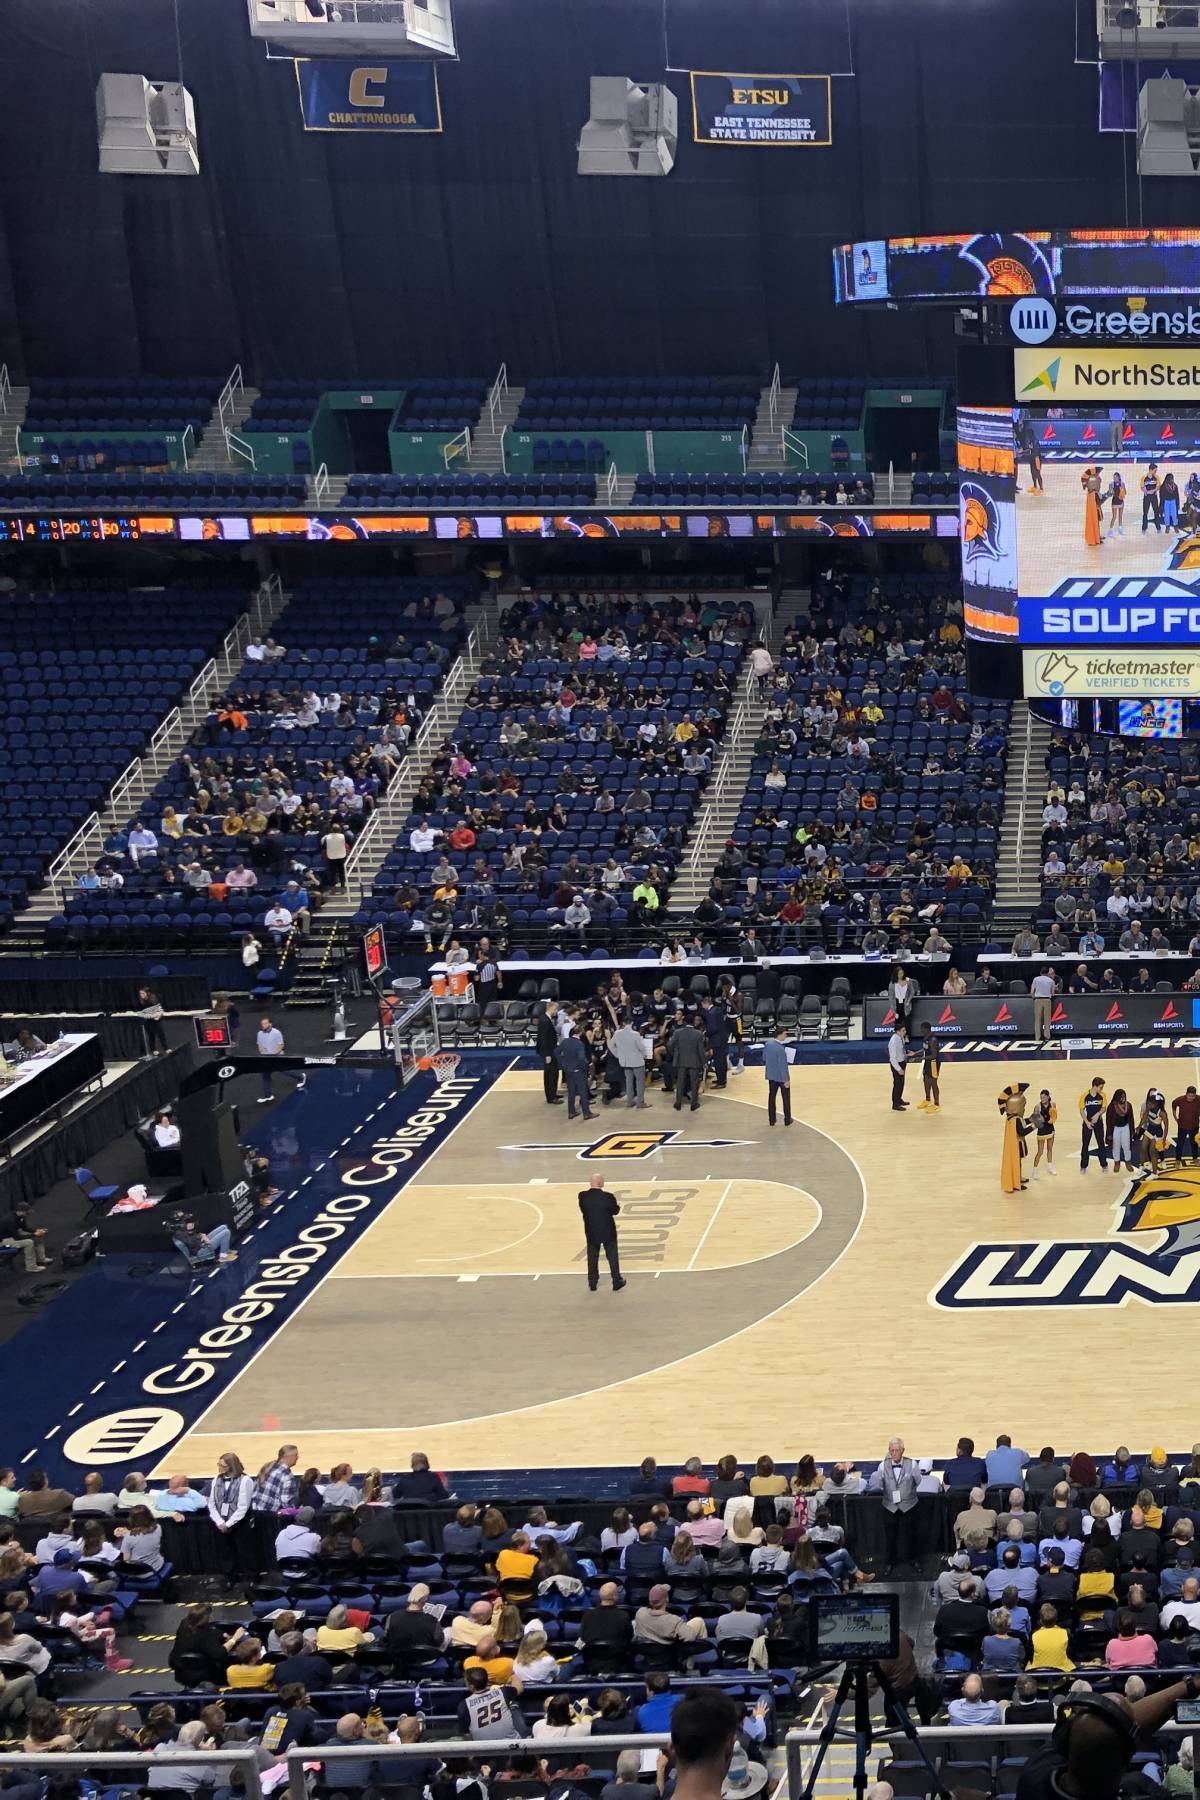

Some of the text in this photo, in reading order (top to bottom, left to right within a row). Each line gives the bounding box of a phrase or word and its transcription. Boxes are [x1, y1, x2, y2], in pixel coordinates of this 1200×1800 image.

[349, 67, 388, 107] C
[732, 89, 789, 105] ETSU
[328, 112, 417, 124] CHATTANOOGA
[714, 117, 811, 128] EAST TENNESSEE
[710, 128, 816, 140] STATE UNIVERSITY
[26, 523, 36, 535] 4
[63, 523, 81, 534] 20
[103, 523, 119, 535] 50
[1043, 607, 1156, 633] SOUP
[1086, 659, 1195, 675] ticketmaster
[1086, 678, 1190, 687] VERIFIED TICKETS
[205, 1028, 225, 1043] 30
[589, 1134, 666, 1156] G
[142, 1078, 480, 1395] Greensboro Coliseum
